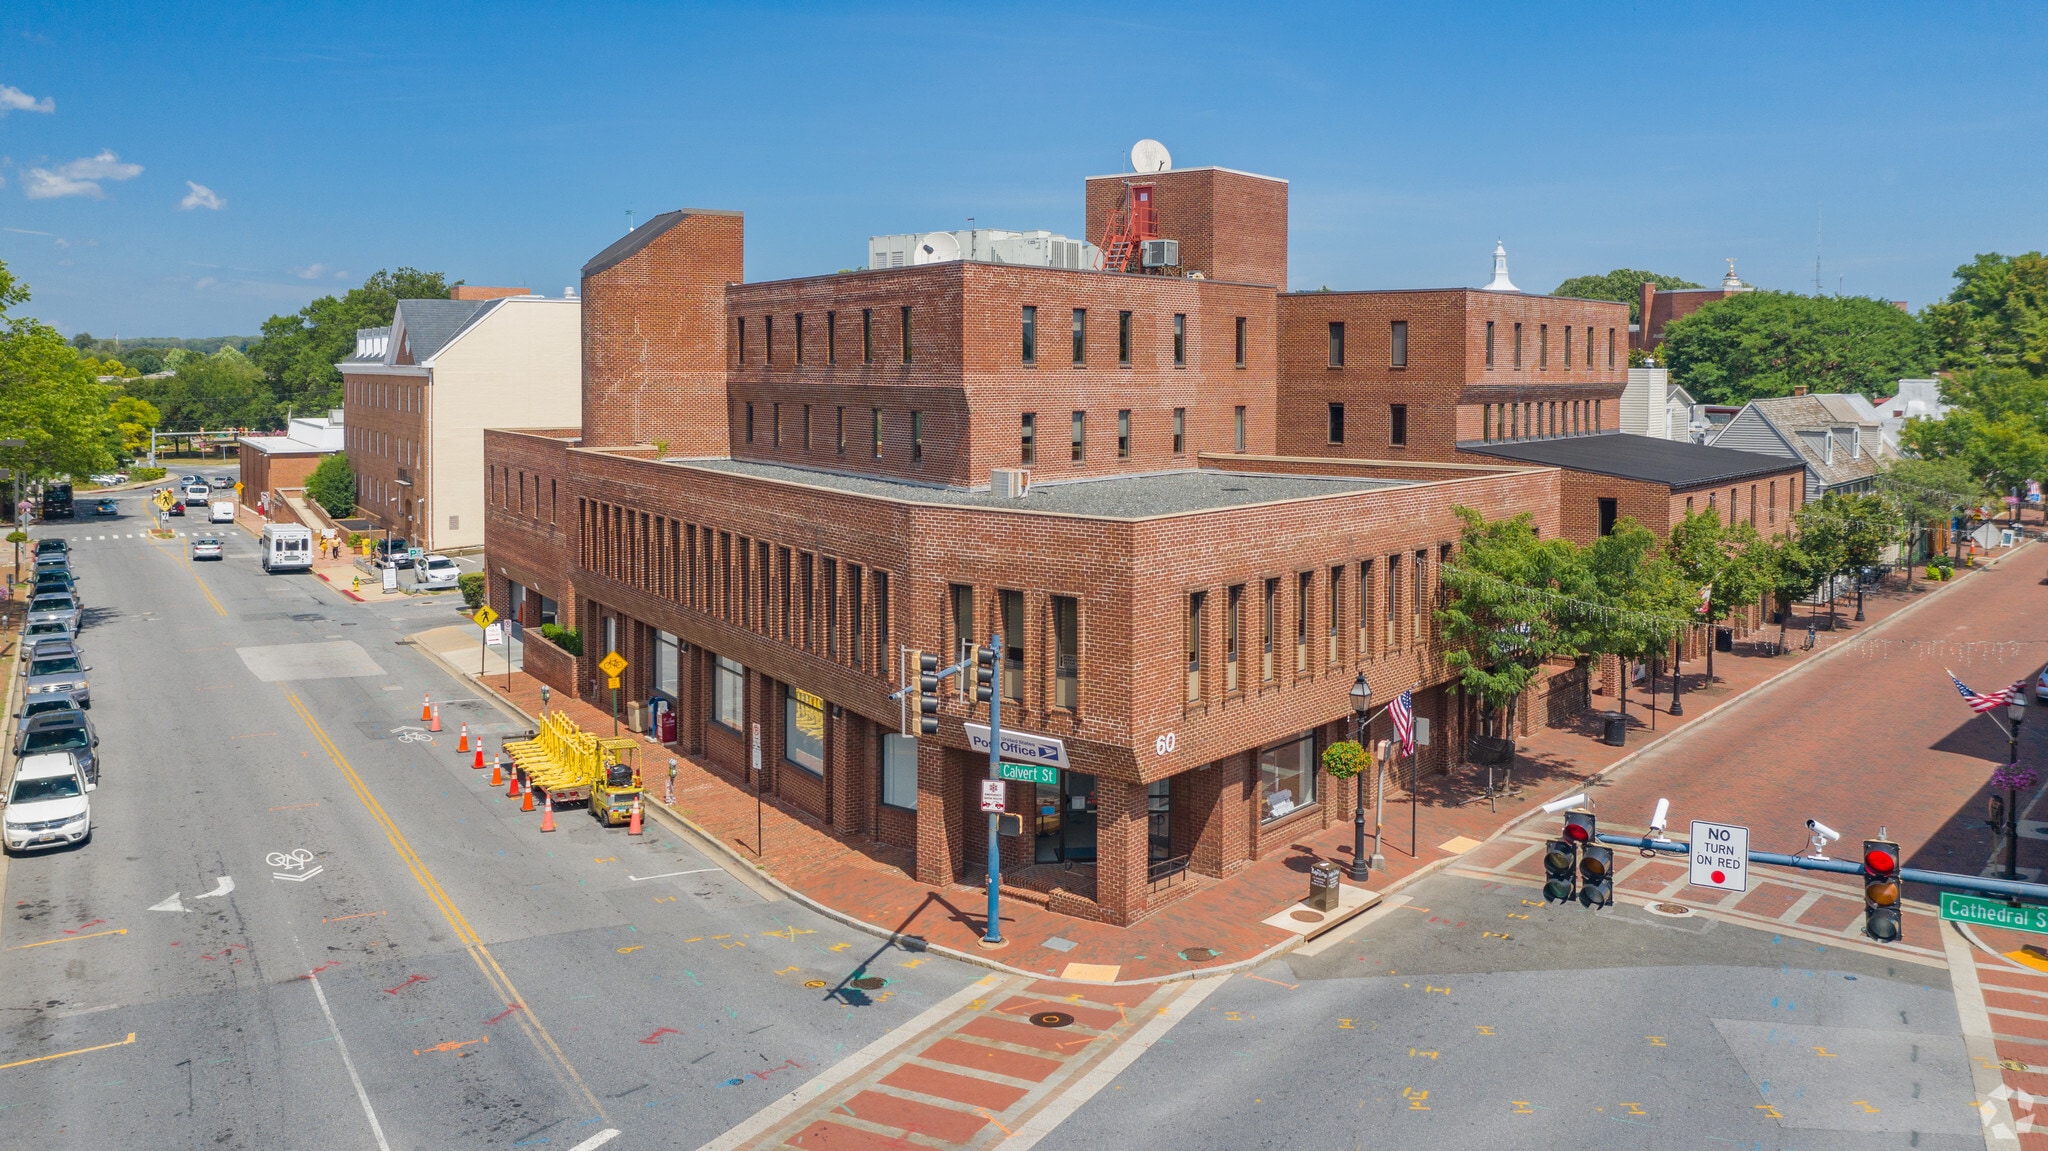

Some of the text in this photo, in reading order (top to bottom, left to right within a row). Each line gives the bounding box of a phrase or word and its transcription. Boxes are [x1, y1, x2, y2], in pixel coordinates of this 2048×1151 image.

[1000, 741, 1037, 757] Office
[1156, 732, 1176, 756] 60
[1003, 764, 1053, 782] Calvert St
[1708, 827, 1731, 841] NO
[1704, 842, 1734, 855] TURN
[1696, 854, 1741, 869] ON RED
[1949, 899, 2028, 925] Cathedral
